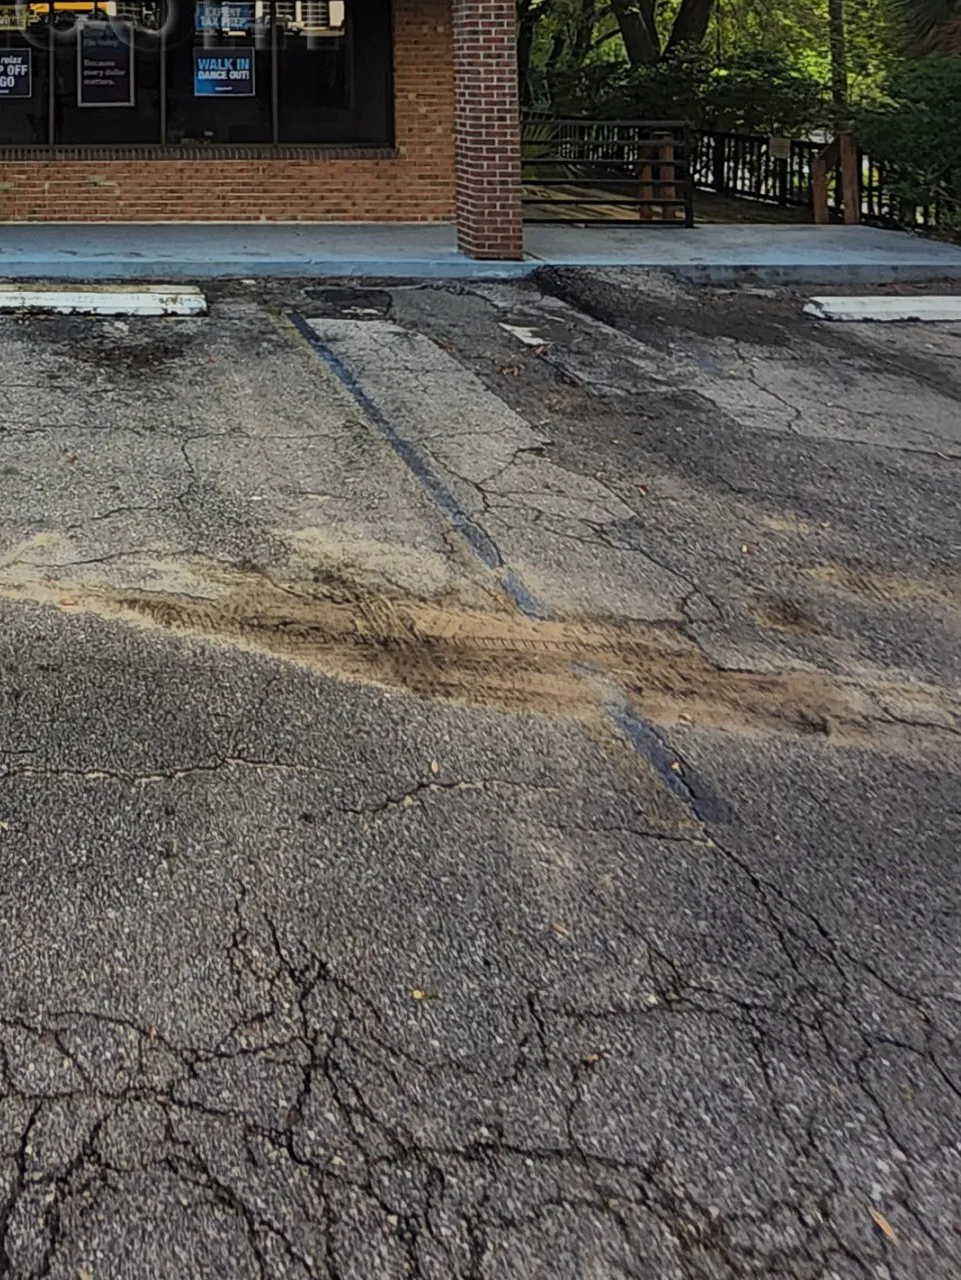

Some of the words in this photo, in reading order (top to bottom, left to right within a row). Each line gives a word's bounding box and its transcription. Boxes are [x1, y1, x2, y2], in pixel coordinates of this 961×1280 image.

[200, 18, 220, 28] TAX
[0, 55, 23, 65] relax
[198, 58, 233, 70] WALK
[236, 57, 250, 70] IN
[7, 64, 28, 76] OFF
[197, 70, 227, 80] DANCE
[0, 76, 15, 88] GO
